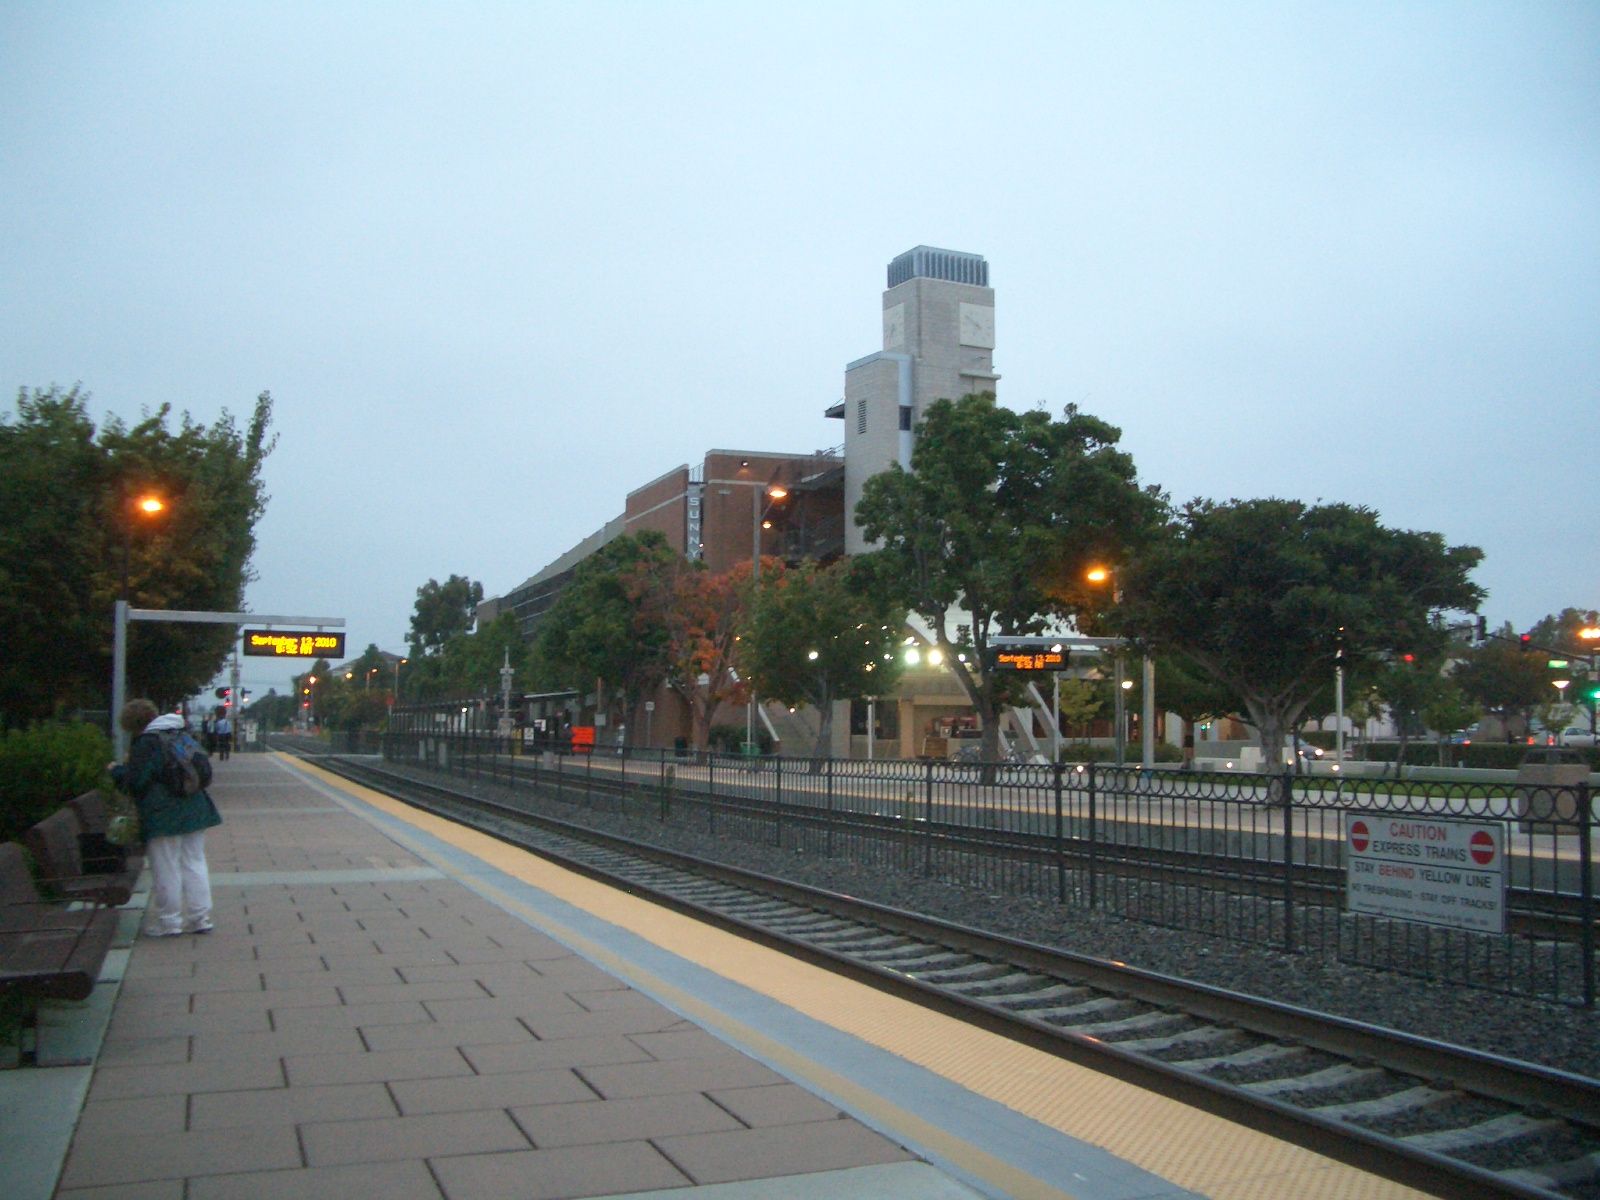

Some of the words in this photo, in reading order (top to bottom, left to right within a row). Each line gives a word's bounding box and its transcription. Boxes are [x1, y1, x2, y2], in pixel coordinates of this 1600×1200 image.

[252, 635, 298, 646] September
[1390, 822, 1447, 841] CAUTION
[1372, 841, 1421, 857] EXPRESS
[1425, 845, 1467, 862] TRAINS
[1354, 862, 1374, 874] STAY
[1379, 864, 1415, 879] BEHIND
[1419, 868, 1462, 885] YELLOW
[1466, 875, 1492, 889] LINE
